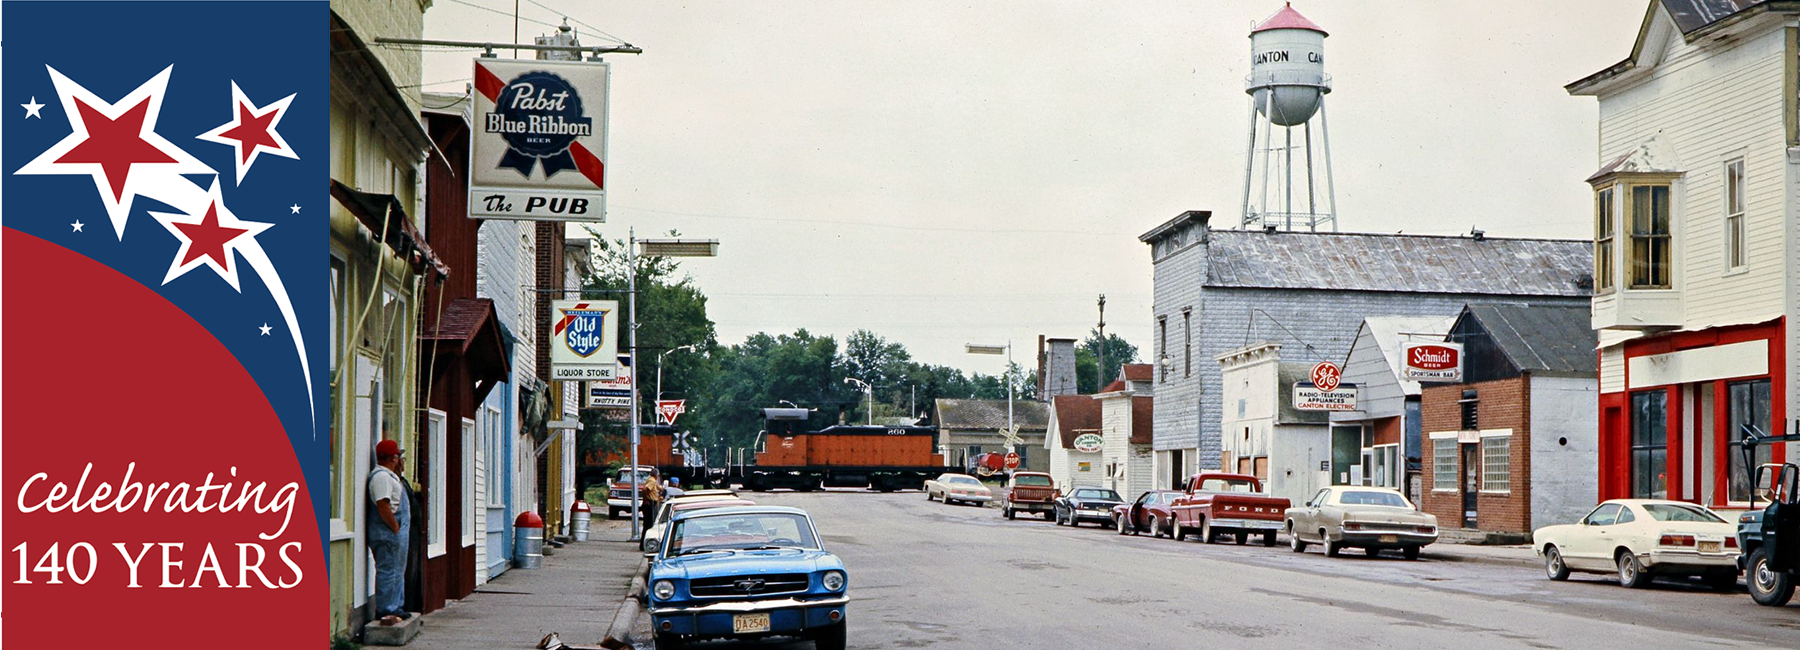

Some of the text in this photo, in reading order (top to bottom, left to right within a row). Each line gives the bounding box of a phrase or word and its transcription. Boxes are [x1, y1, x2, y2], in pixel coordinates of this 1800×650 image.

[1253, 50, 1289, 65] CANTON
[510, 82, 569, 112] Pabst
[487, 113, 590, 136] Blue Ribbon
[483, 194, 589, 214] The PUB
[574, 316, 596, 333] Old
[568, 331, 600, 354] Style
[1413, 347, 1451, 364] Schmidt
[557, 369, 583, 377] LIQUOR
[1075, 435, 1103, 446] CANTON
[1006, 456, 1019, 465] STOP
[1224, 505, 1279, 514] FORD
